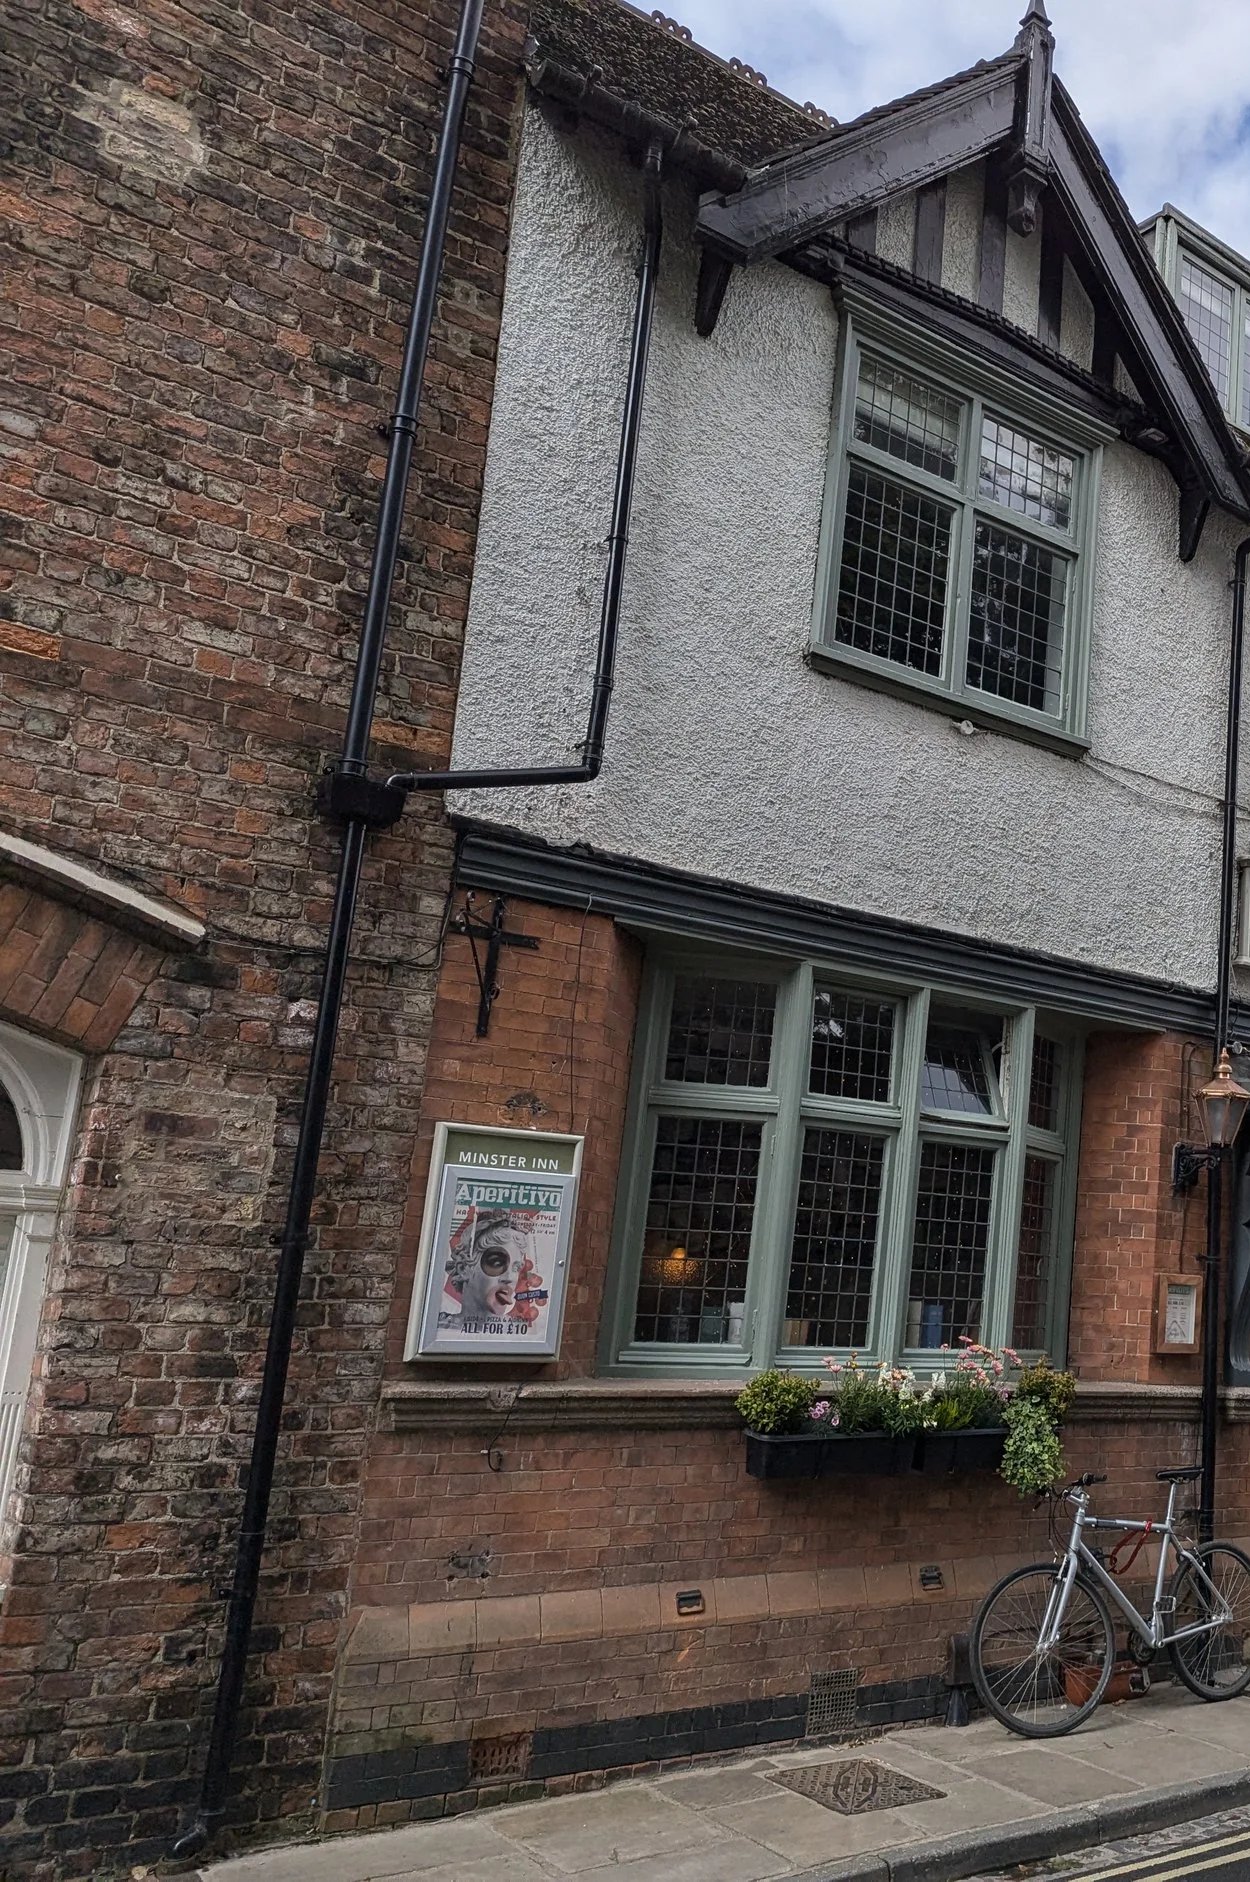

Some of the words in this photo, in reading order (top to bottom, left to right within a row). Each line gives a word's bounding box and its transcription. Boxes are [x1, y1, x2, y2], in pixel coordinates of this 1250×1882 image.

[458, 1151, 526, 1168] MINSTER
[532, 1158, 559, 1170] INN
[455, 1183, 562, 1207] Aperitivo
[536, 1214, 557, 1222] STYLE
[461, 1322, 480, 1334] ALL
[483, 1323, 504, 1335] FOR
[507, 1323, 528, 1335] £10
